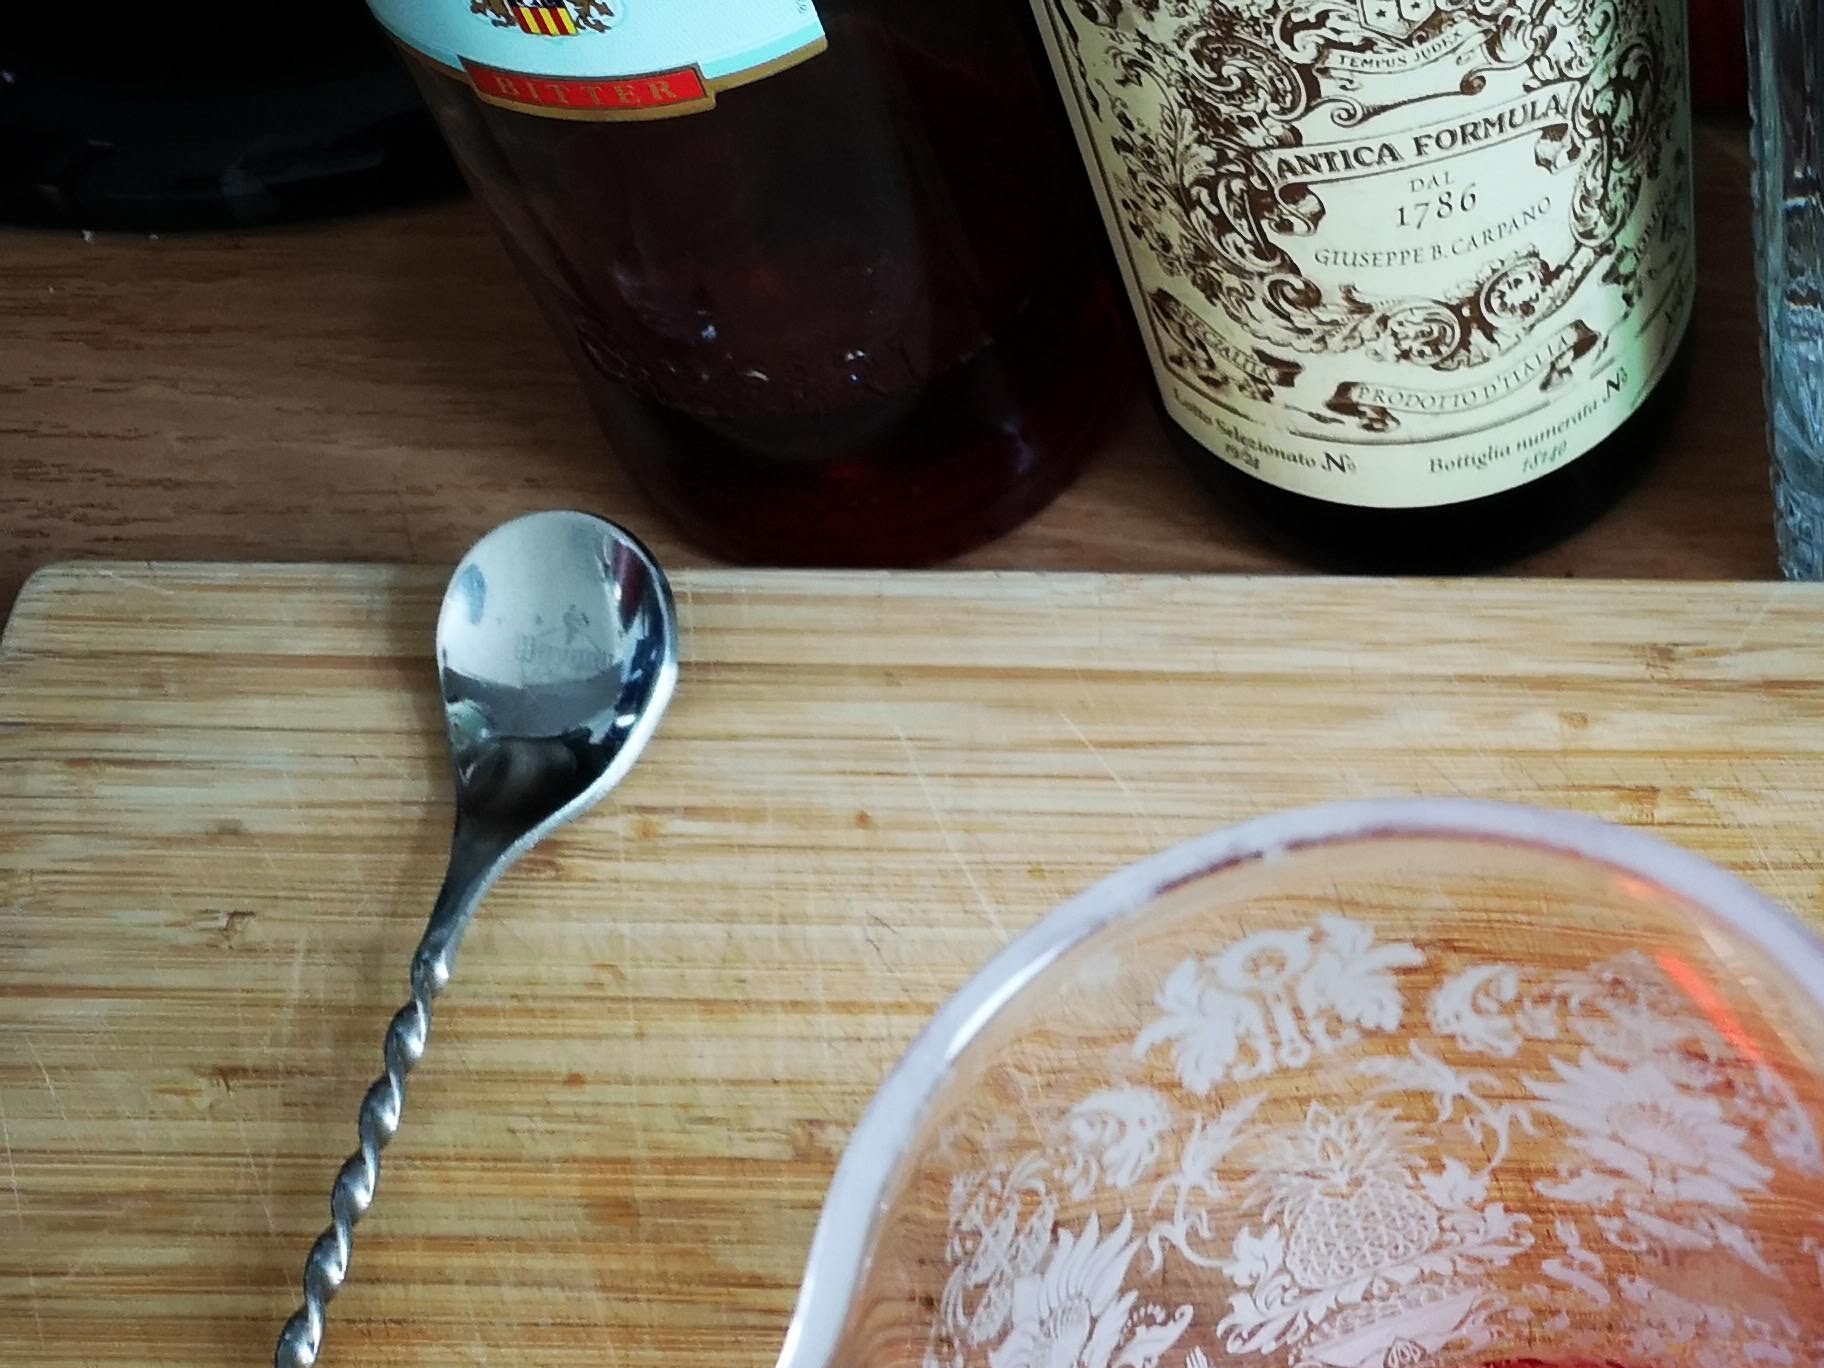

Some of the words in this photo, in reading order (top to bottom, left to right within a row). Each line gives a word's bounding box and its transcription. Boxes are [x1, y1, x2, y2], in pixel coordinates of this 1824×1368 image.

[1338, 53, 1408, 68] TEMPUS
[1414, 29, 1463, 63] JUDEX
[495, 76, 677, 105] BITTER
[1276, 142, 1405, 180] ANTICA
[1412, 92, 1568, 157] FORMULA
[1410, 171, 1455, 193] DAL
[1397, 181, 1478, 230] 1786
[1314, 247, 1424, 268] GIUSEPPE
[1432, 243, 1449, 262] B.
[1451, 196, 1553, 256] CARPANO
[1358, 385, 1476, 410] PRODOTTO
[1482, 336, 1572, 397] D'ITALIA
[1429, 445, 1511, 473] Bottiglia
